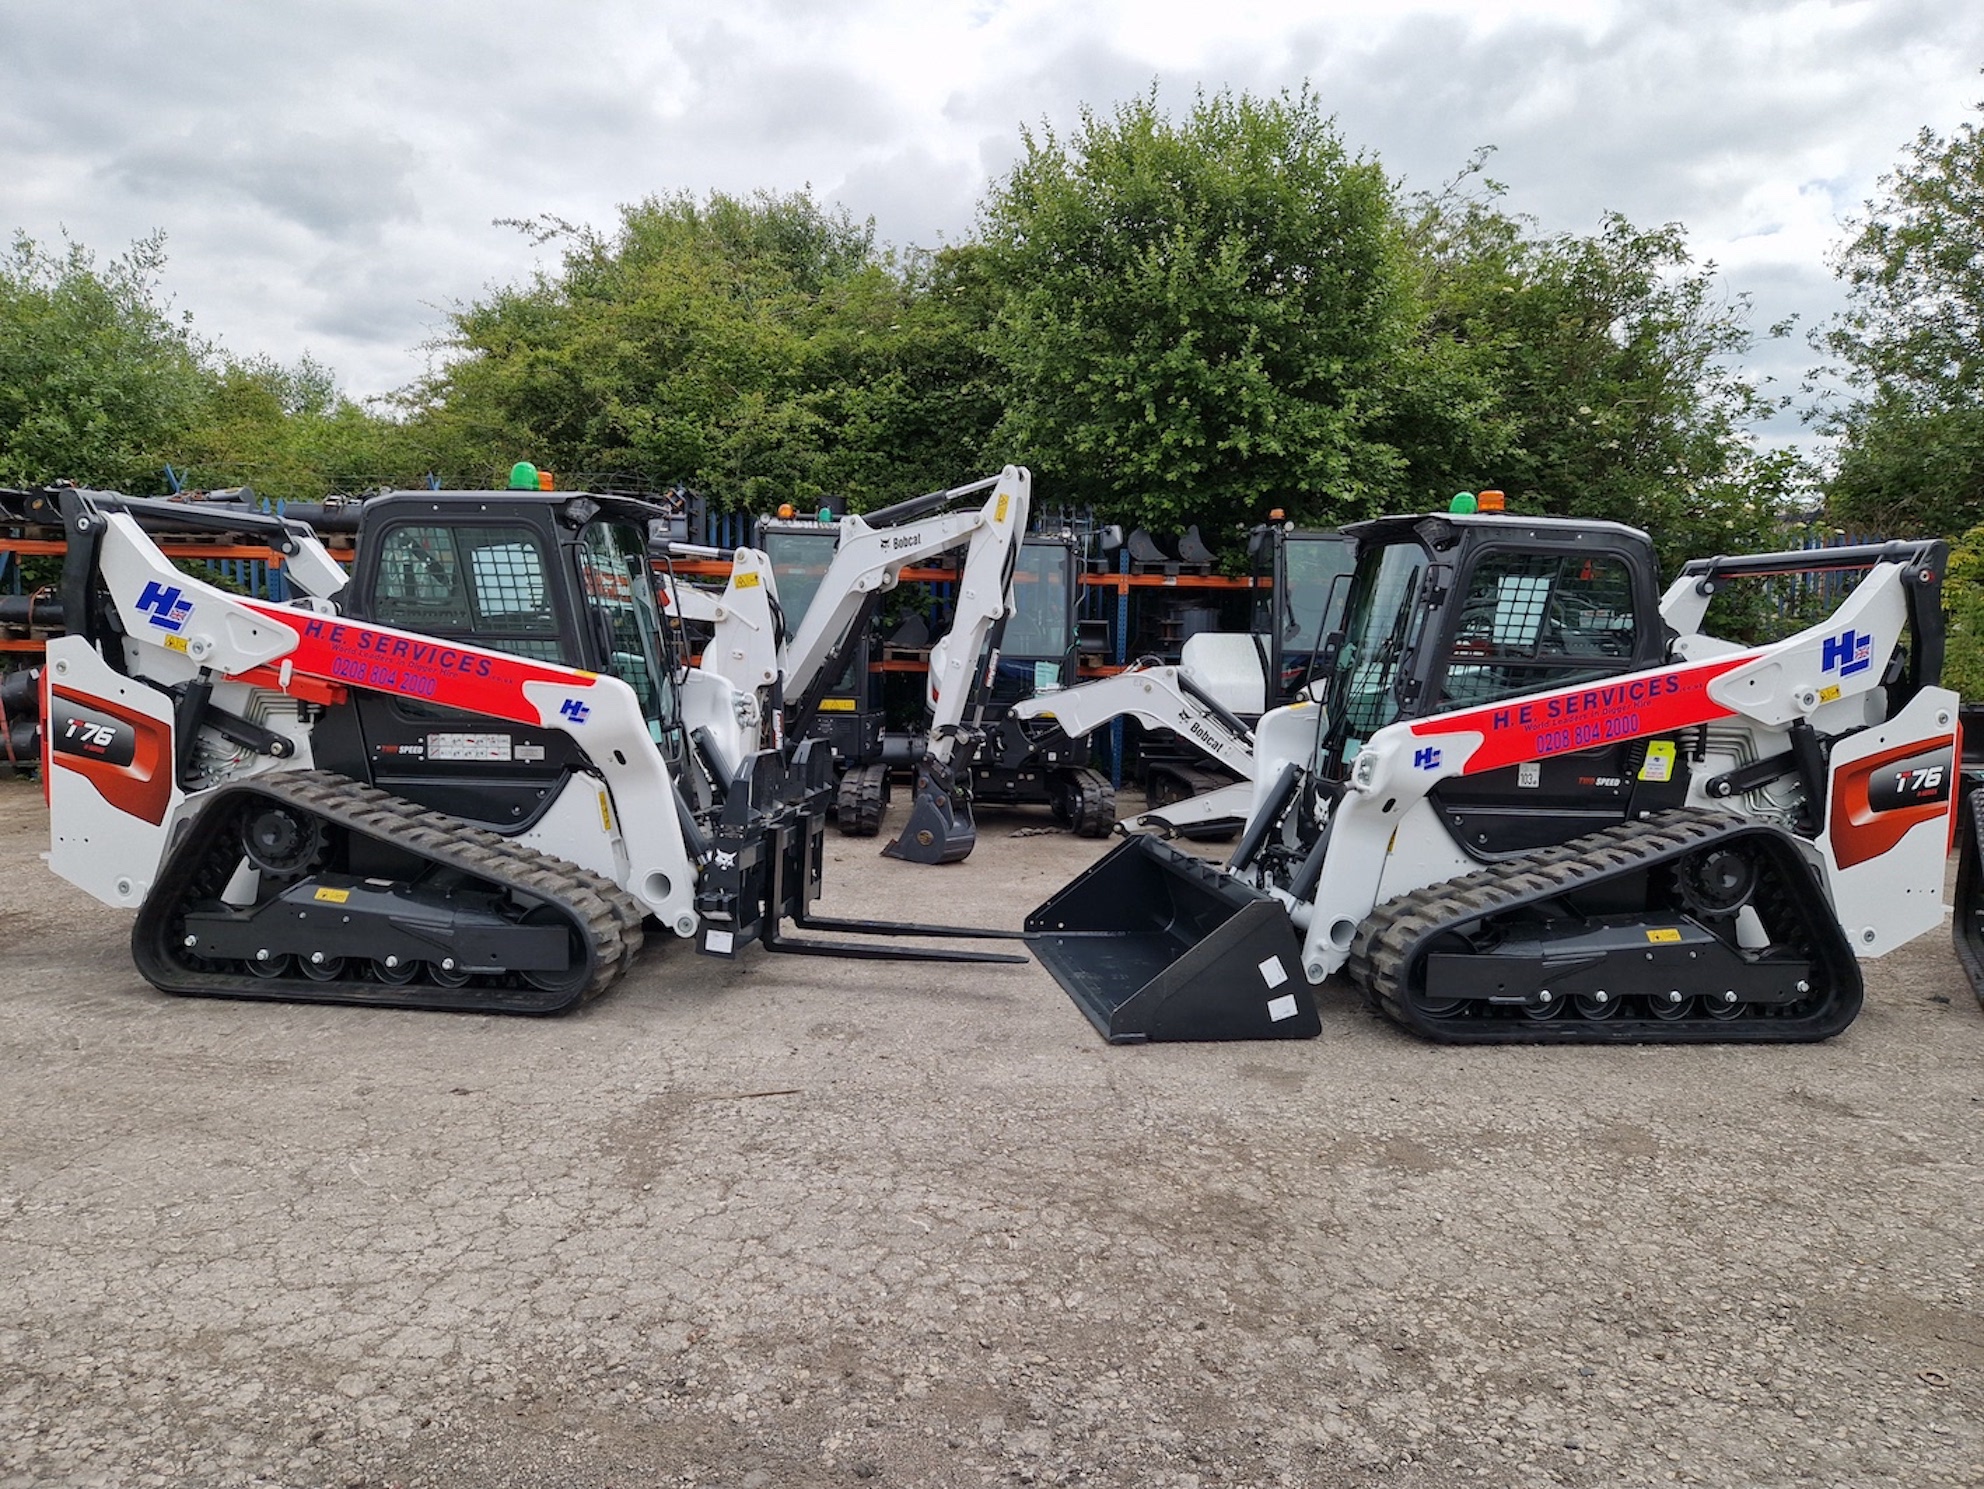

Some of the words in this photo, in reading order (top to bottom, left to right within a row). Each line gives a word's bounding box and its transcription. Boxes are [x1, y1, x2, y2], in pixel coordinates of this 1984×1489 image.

[893, 533, 921, 550] Bobcat
[304, 619, 347, 645] H.E.
[357, 631, 492, 677] SERVICES
[331, 643, 356, 655] World
[359, 649, 394, 664] Leaders
[408, 661, 438, 674] Digger
[440, 668, 459, 679] Hire
[332, 657, 367, 681] 0208
[369, 665, 398, 685] 804
[400, 672, 436, 696] 2000
[1493, 705, 1538, 730] H.E.
[1547, 675, 1679, 718] SERVICES
[1524, 721, 1549, 732] World
[1552, 714, 1587, 726] Leaders
[1603, 704, 1631, 715] Digger
[1633, 700, 1652, 709] Hire
[65, 718, 117, 746] T76
[1190, 722, 1223, 753] Bobcat
[1536, 729, 1570, 753] 0208
[1575, 723, 1600, 745] 804
[1605, 713, 1639, 738] 2000
[1595, 777, 1621, 787] SPEED
[1895, 765, 1945, 793] T76
